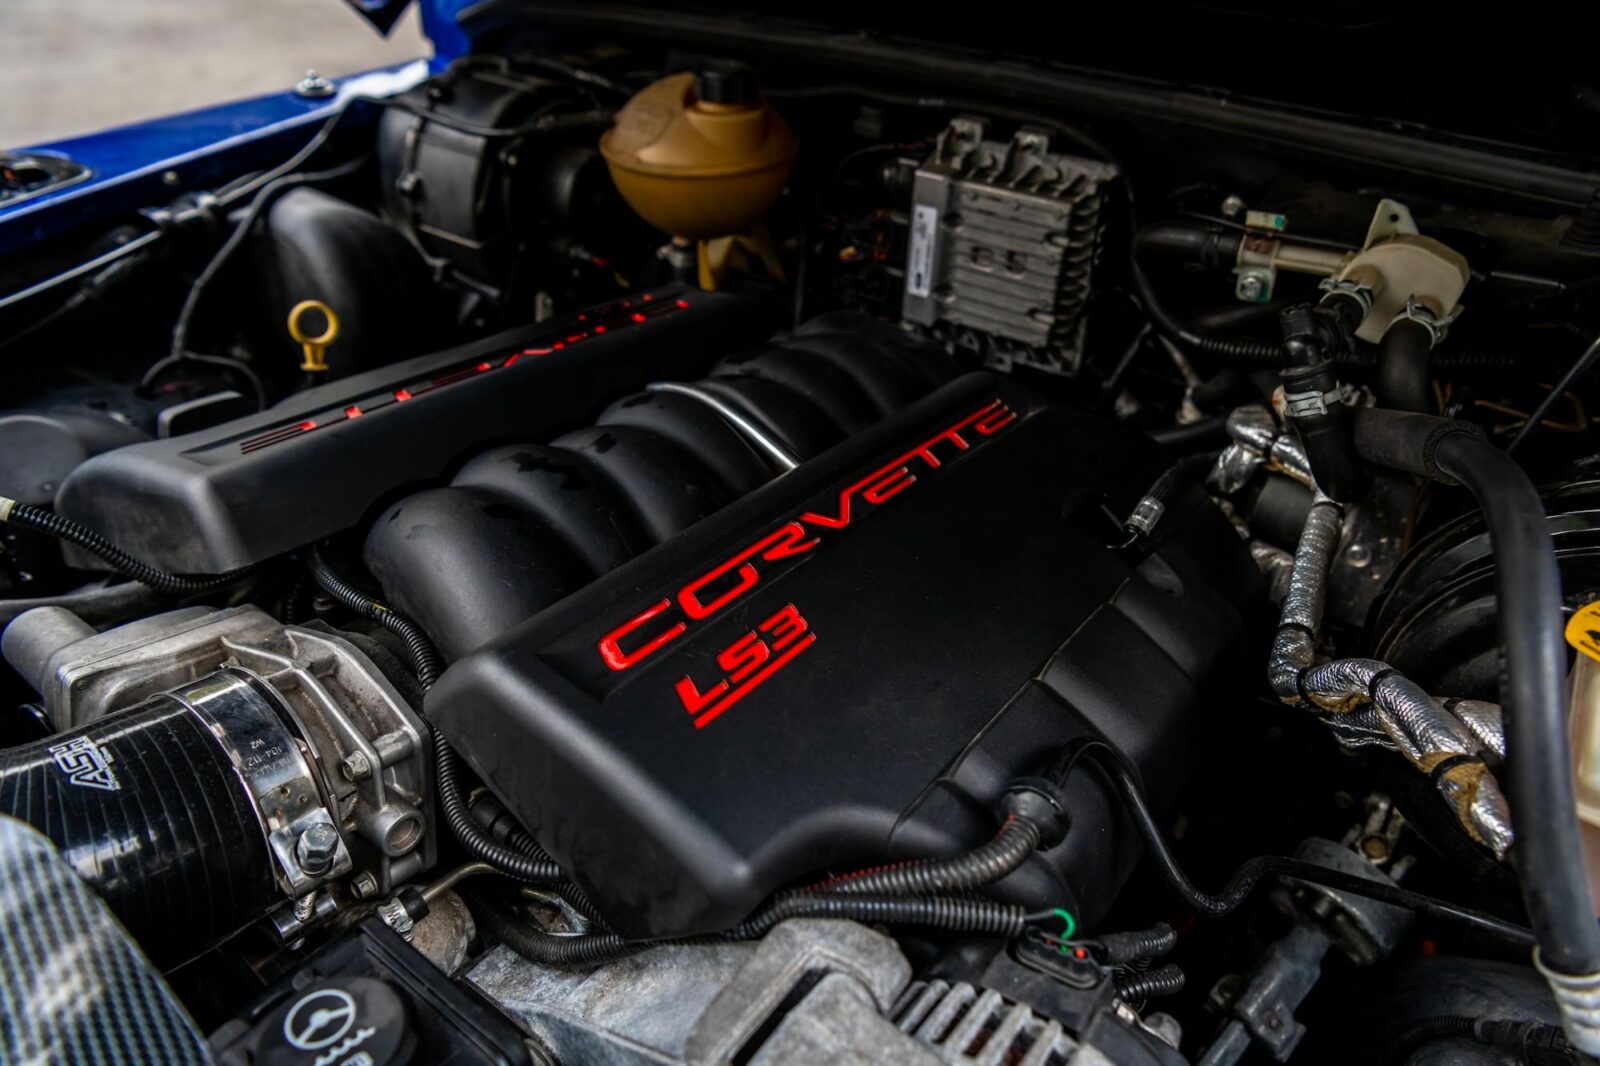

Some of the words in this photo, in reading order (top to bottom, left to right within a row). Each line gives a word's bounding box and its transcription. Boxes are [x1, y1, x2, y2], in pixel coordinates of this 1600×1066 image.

[598, 398, 1017, 672] CORVETTE
[674, 602, 812, 718] LS3
[247, 746, 282, 767] 104-112
[250, 739, 266, 750] W2
